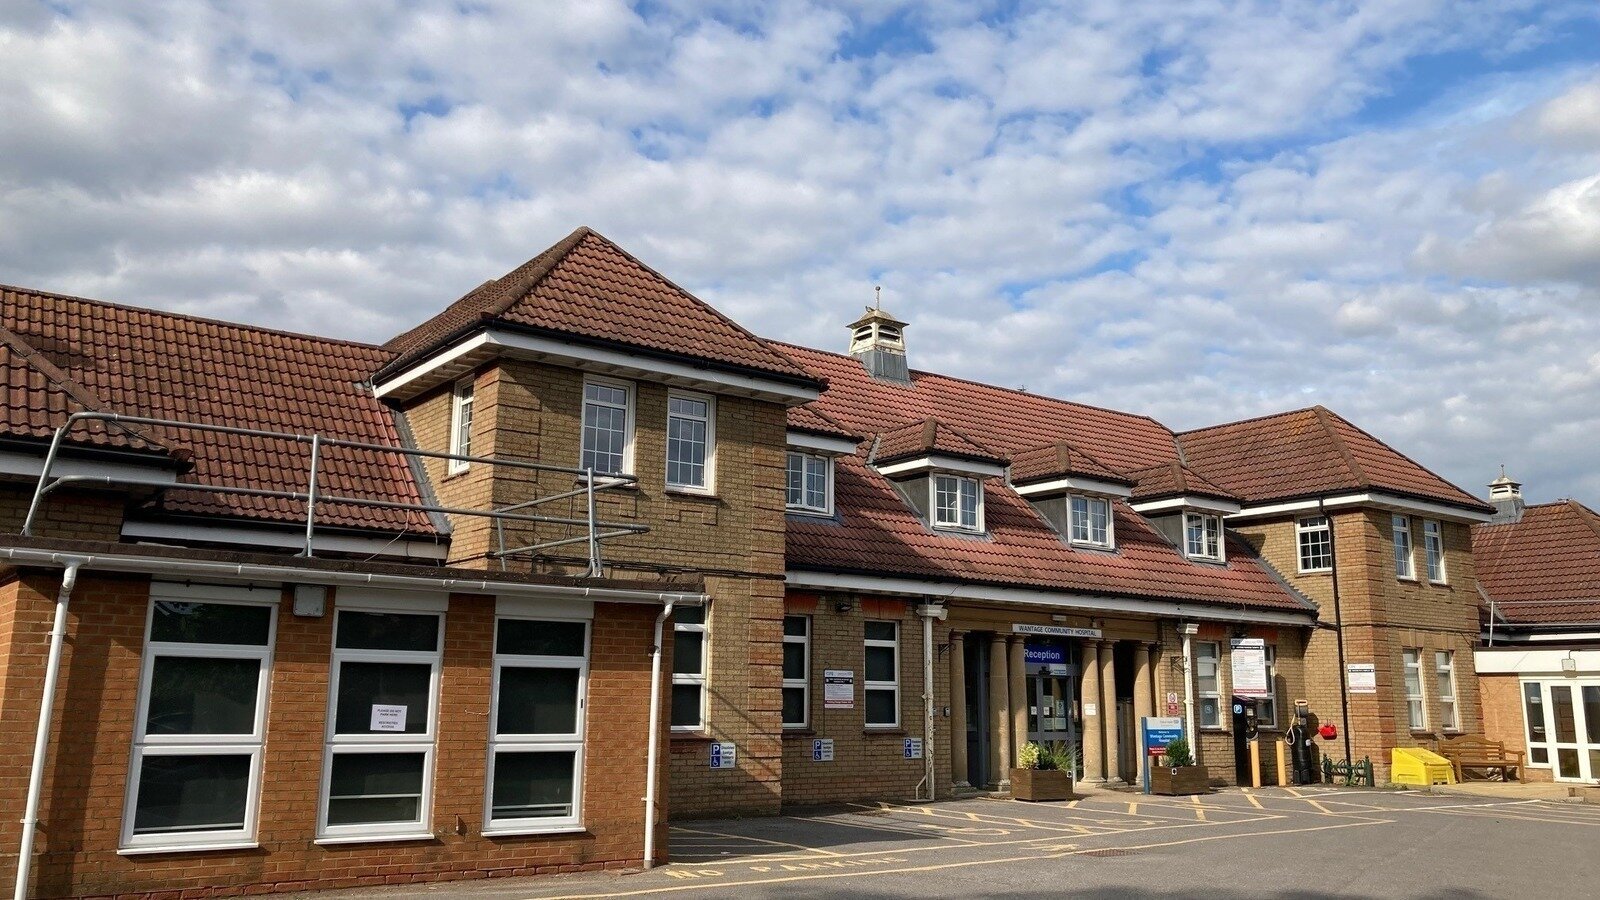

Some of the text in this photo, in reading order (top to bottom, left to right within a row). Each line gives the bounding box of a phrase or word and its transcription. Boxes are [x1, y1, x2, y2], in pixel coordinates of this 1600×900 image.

[1018, 625, 1044, 633] WANTAGE
[1045, 627, 1074, 635] COMMUNITY
[1024, 649, 1060, 660] Reception
[713, 745, 720, 755] P
[664, 857, 908, 879] NO PARKING
